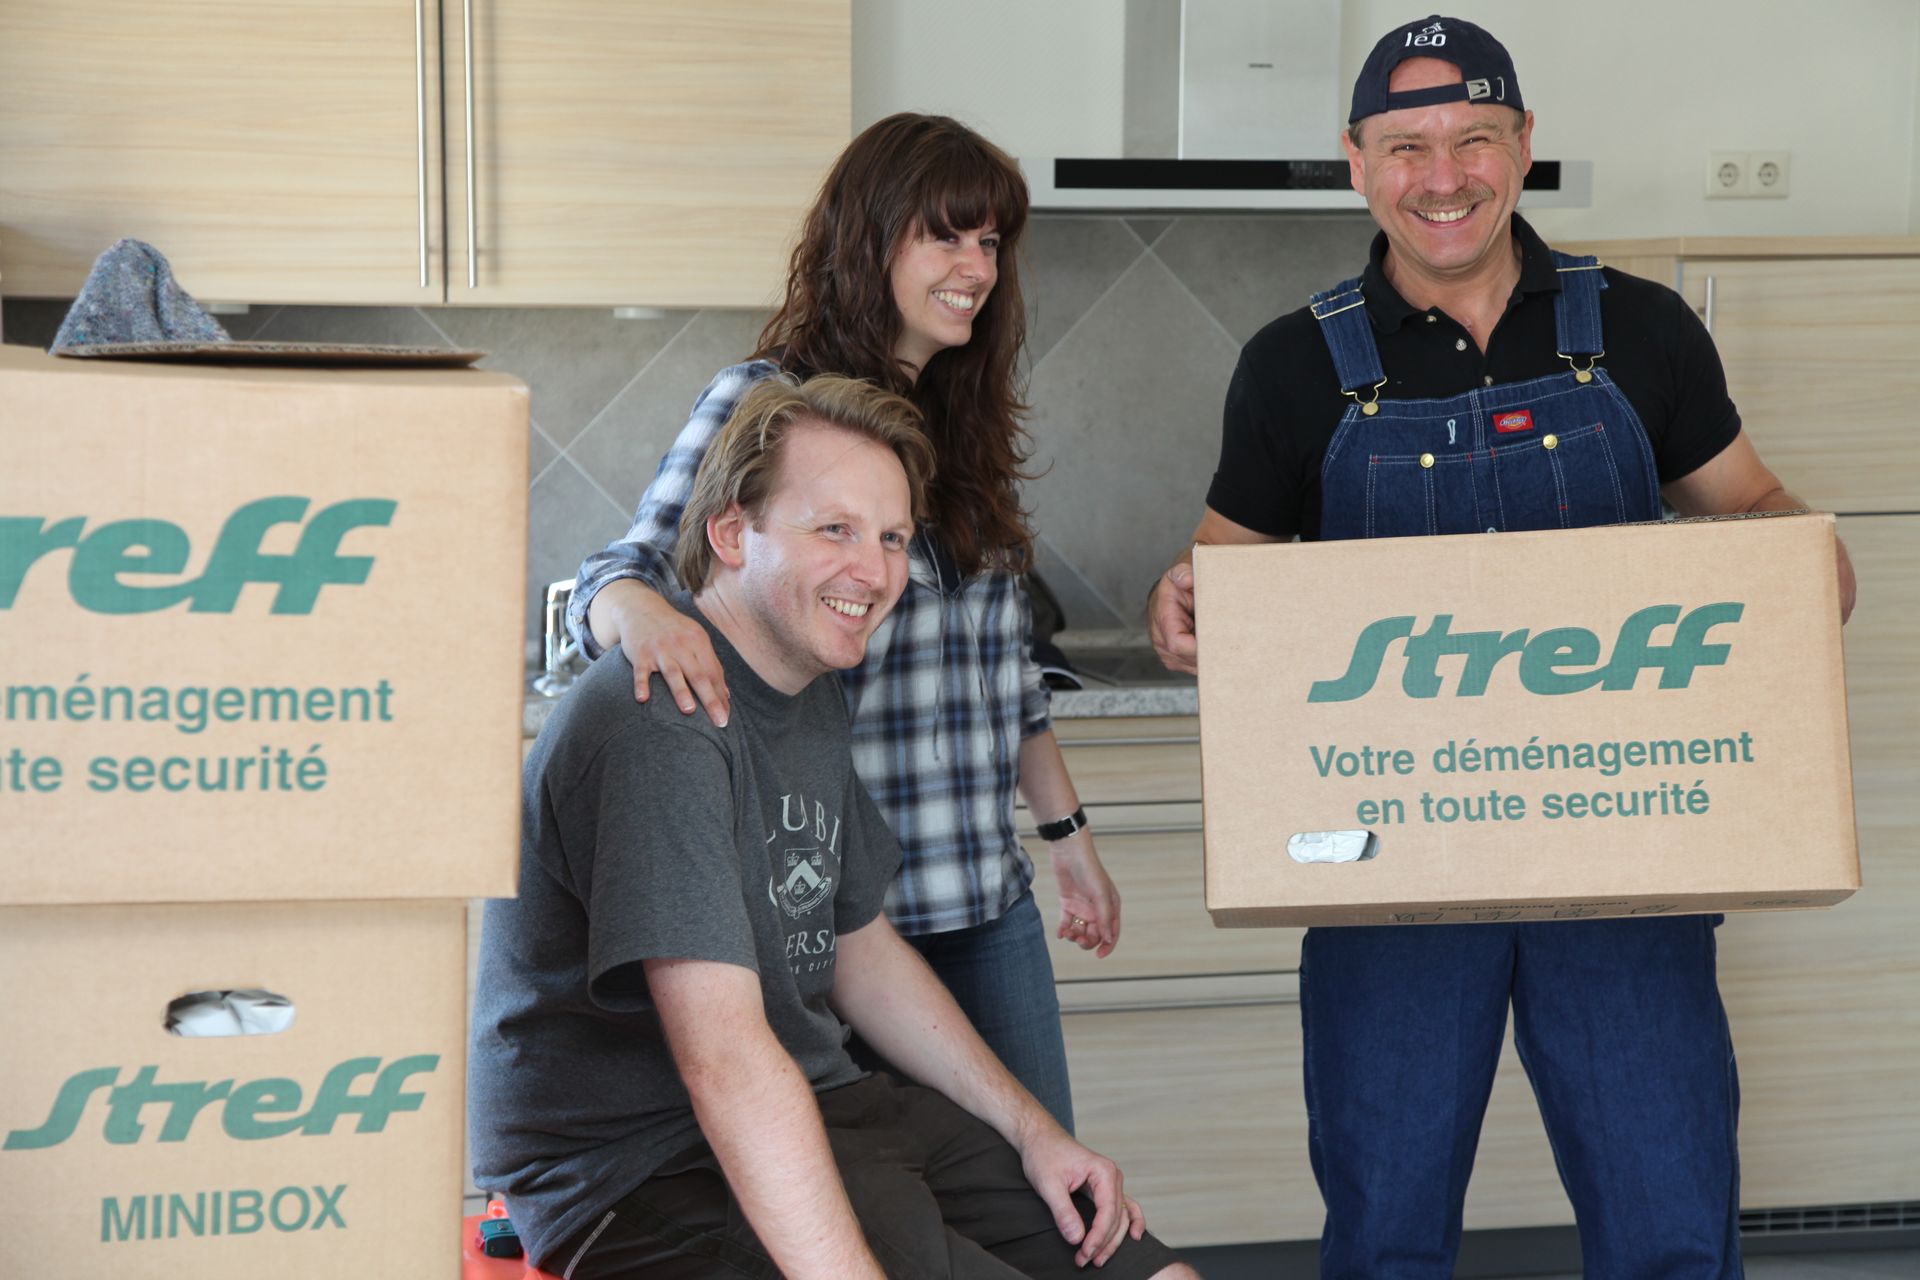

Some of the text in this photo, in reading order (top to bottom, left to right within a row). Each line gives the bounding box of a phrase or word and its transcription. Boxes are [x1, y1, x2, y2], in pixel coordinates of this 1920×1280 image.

[0, 495, 399, 615] reff
[1307, 601, 1746, 703] Streff
[0, 673, 395, 734] ménagement
[0, 743, 329, 793] te securité
[1308, 731, 1755, 778] Votre déménagement
[1356, 779, 1711, 825] en toute securité
[2, 1054, 441, 1151] Streff
[100, 1184, 348, 1243] MINIBOX
